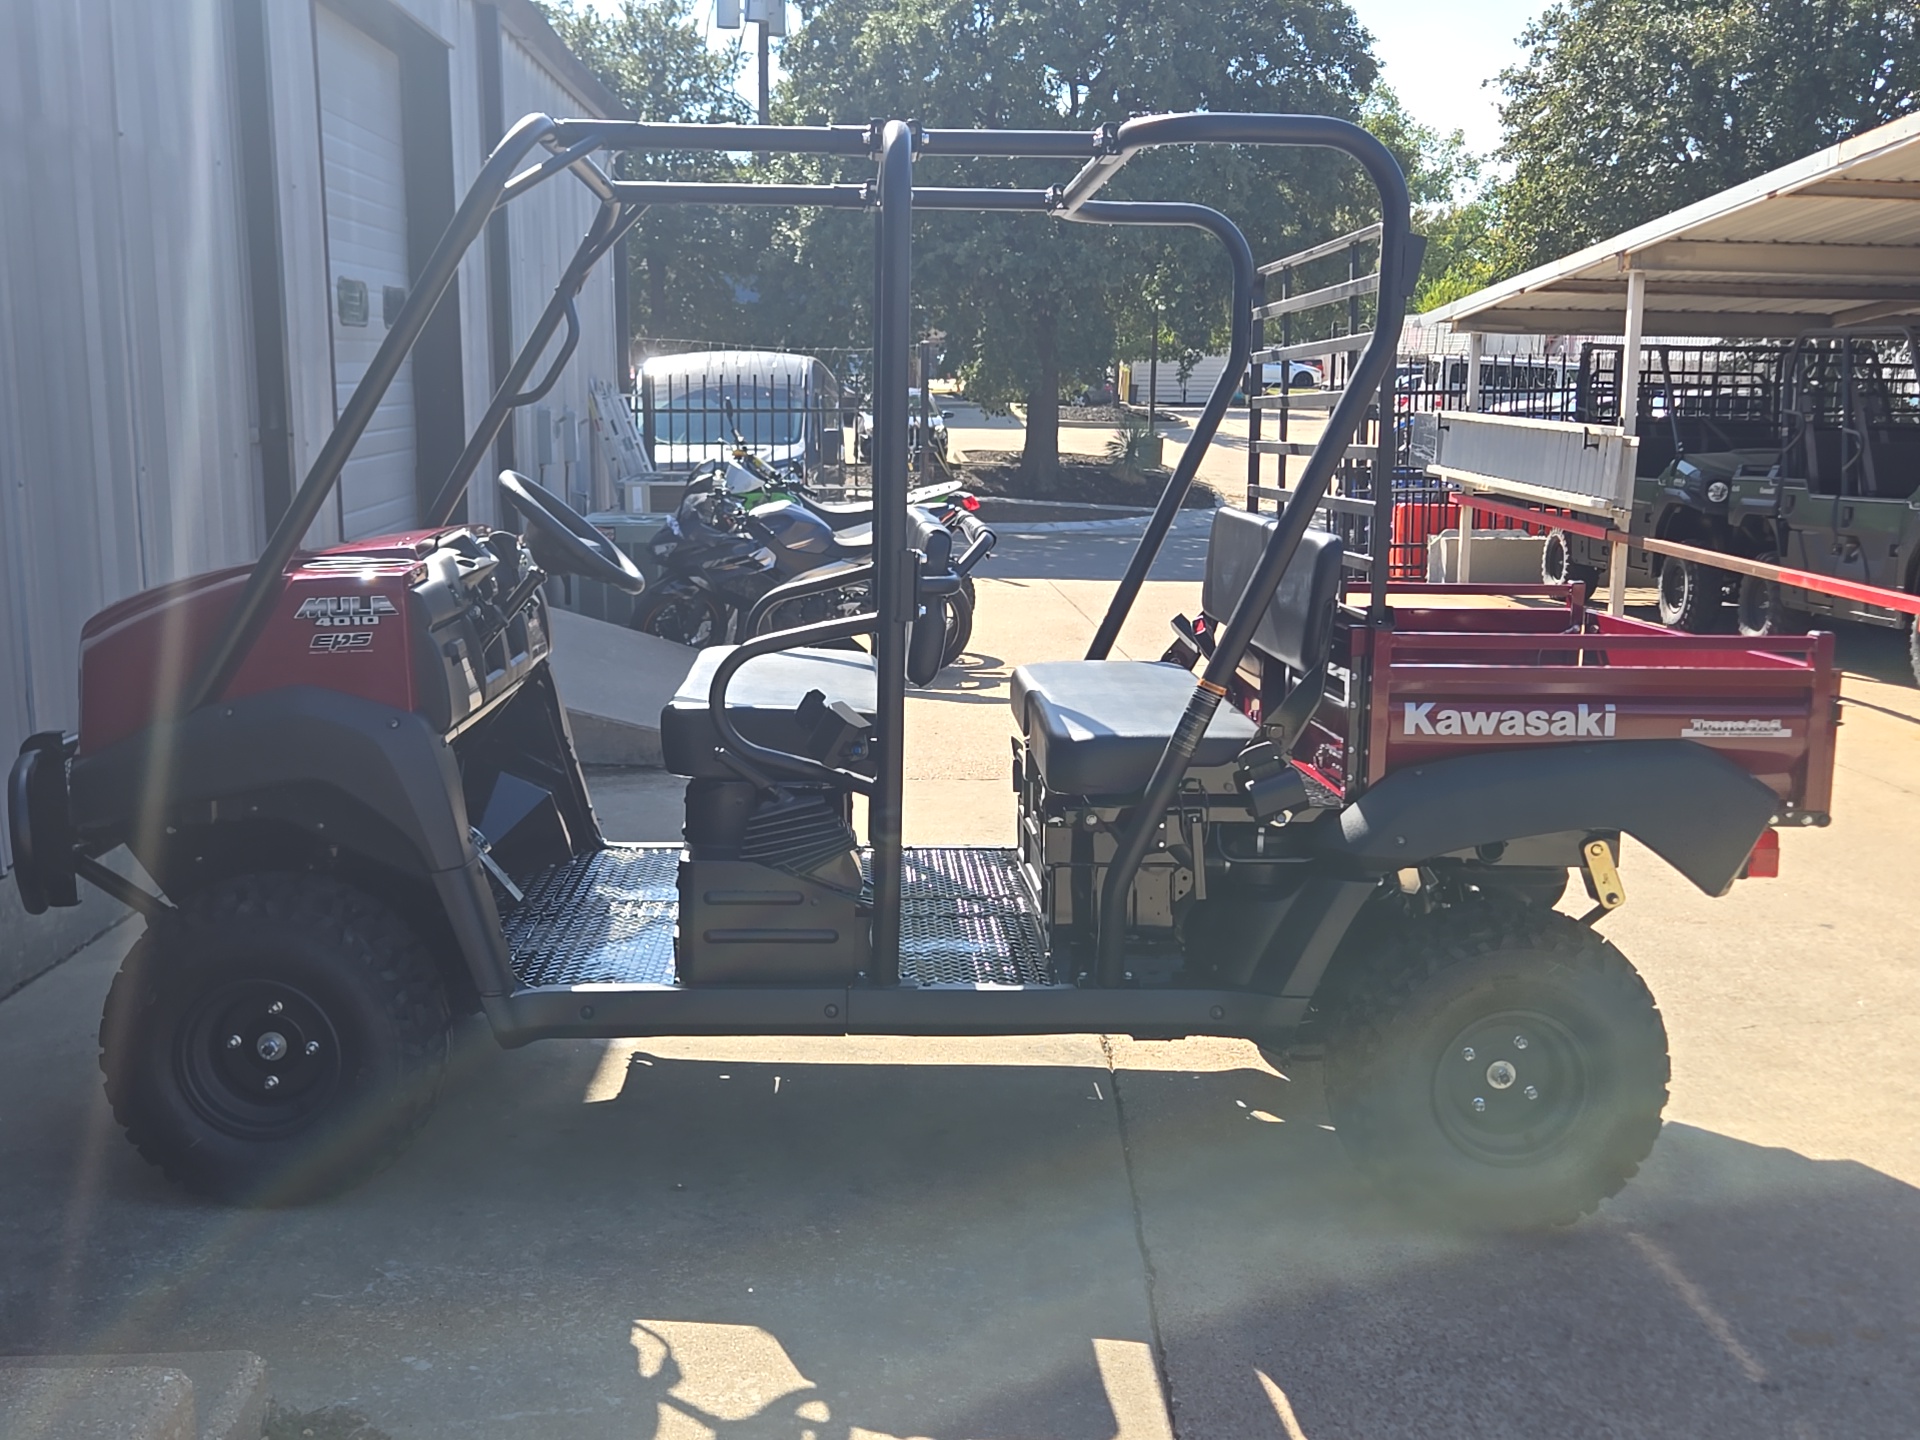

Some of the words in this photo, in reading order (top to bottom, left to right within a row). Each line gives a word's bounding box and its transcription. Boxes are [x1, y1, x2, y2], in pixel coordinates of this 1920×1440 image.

[294, 596, 399, 618] MULE
[315, 616, 379, 626] 4010
[309, 632, 373, 651] EPS
[1403, 702, 1616, 736] Kawasaki
